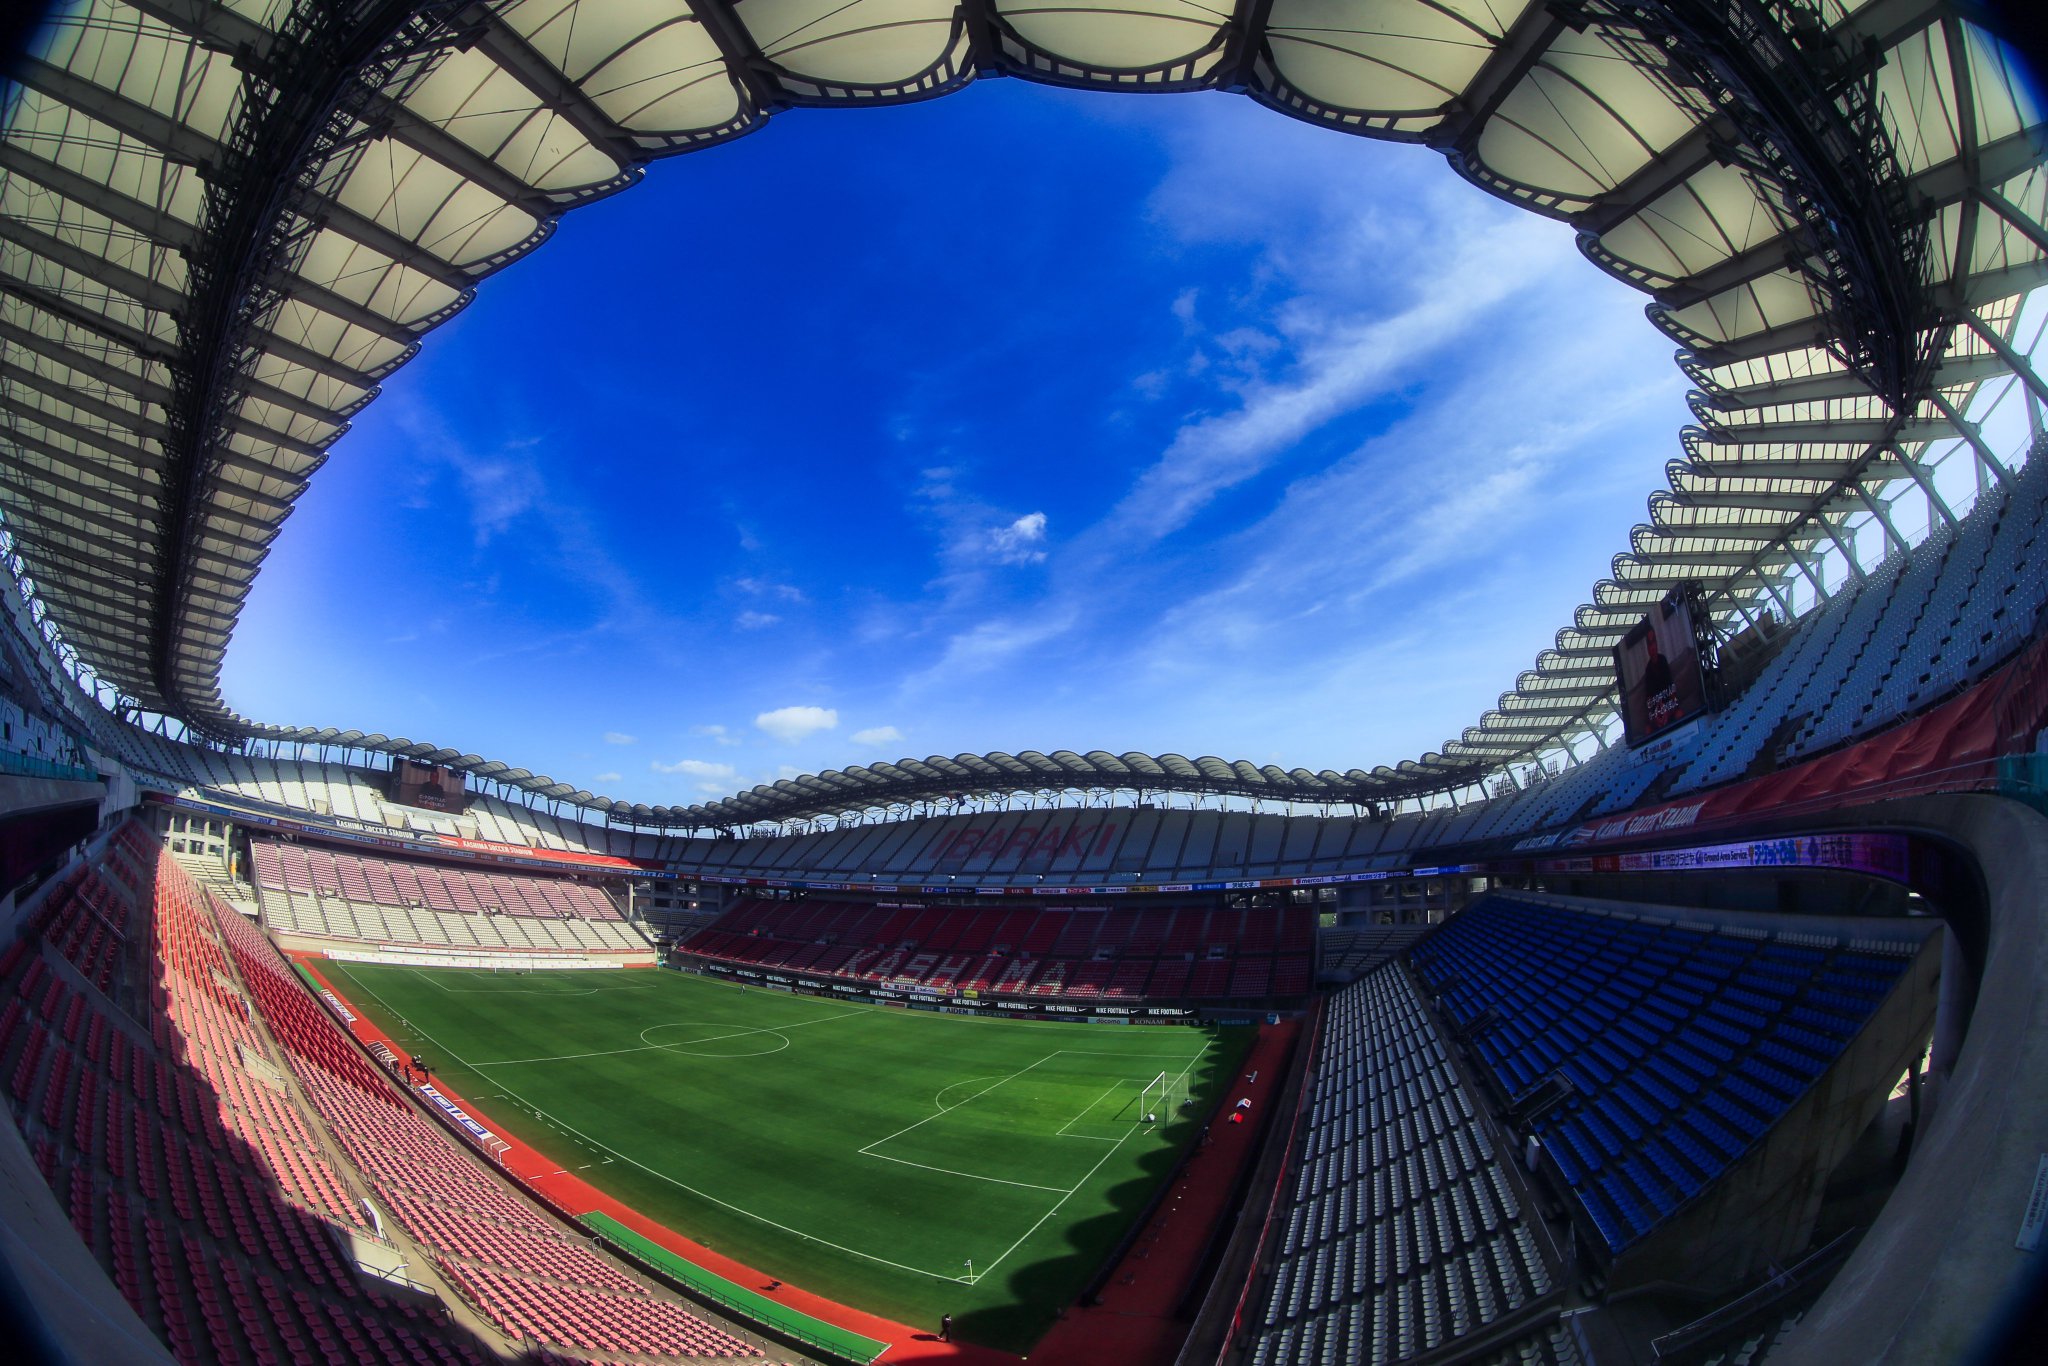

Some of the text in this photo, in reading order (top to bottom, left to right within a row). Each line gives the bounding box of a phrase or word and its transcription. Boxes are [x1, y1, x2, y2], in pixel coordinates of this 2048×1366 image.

[335, 819, 364, 831] KASHIMA
[364, 825, 387, 835] SOCCER
[388, 828, 415, 839] STADIUM
[929, 823, 1117, 859] IBARAKI
[462, 840, 534, 856] KASHIMA SOCCER STADIUM
[1704, 850, 1748, 862] Ground Area Service
[1301, 877, 1324, 885] mercari
[833, 948, 1067, 997] KASHIMA
[806, 981, 821, 989] FOOTBALL
[878, 990, 896, 998] FOOTBALL
[961, 999, 981, 1007] FOOTBALL
[945, 1007, 969, 1015] AIDEM
[1095, 1017, 1121, 1025] docomo
